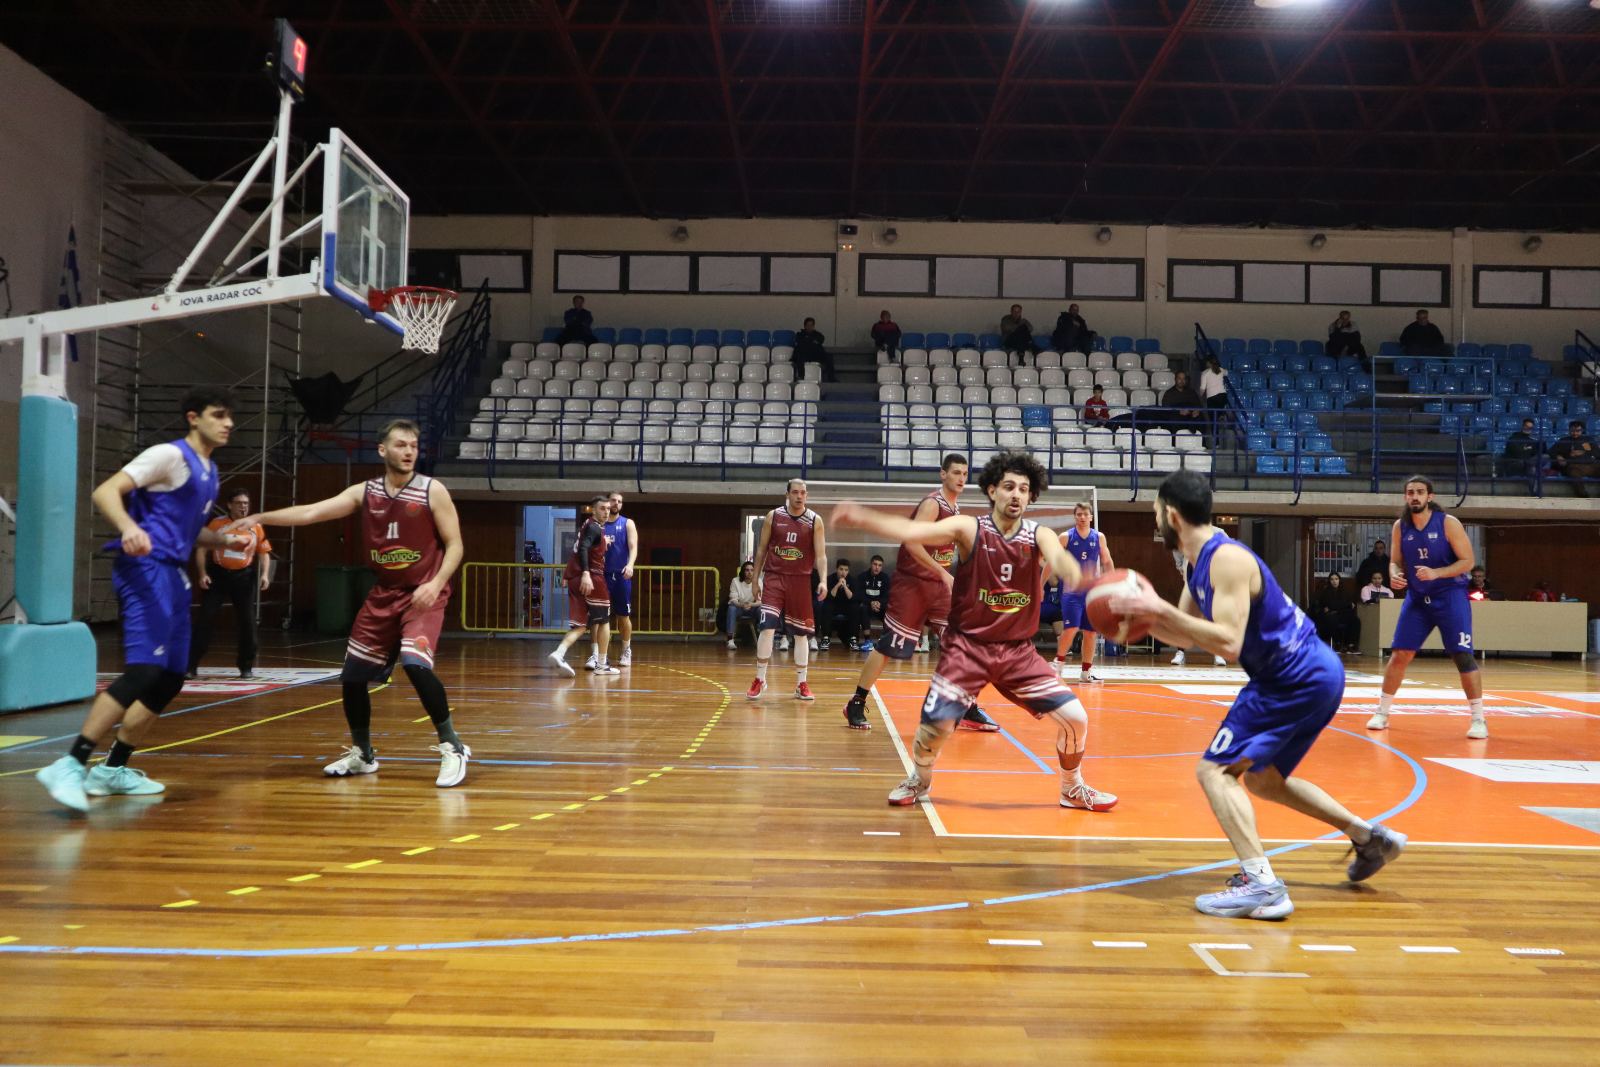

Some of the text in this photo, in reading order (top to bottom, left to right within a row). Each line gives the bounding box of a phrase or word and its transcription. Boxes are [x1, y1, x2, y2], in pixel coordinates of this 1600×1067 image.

[206, 290, 239, 302] RADAR
[386, 522, 400, 539] 11
[786, 531, 798, 543] 10
[1081, 551, 1088, 560] 5
[1417, 547, 1429, 560] 12
[1000, 563, 1013, 582] 9
[890, 633, 906, 649] 14
[1457, 631, 1472, 649] 12
[923, 690, 938, 713] 9
[1209, 727, 1234, 755] 0
